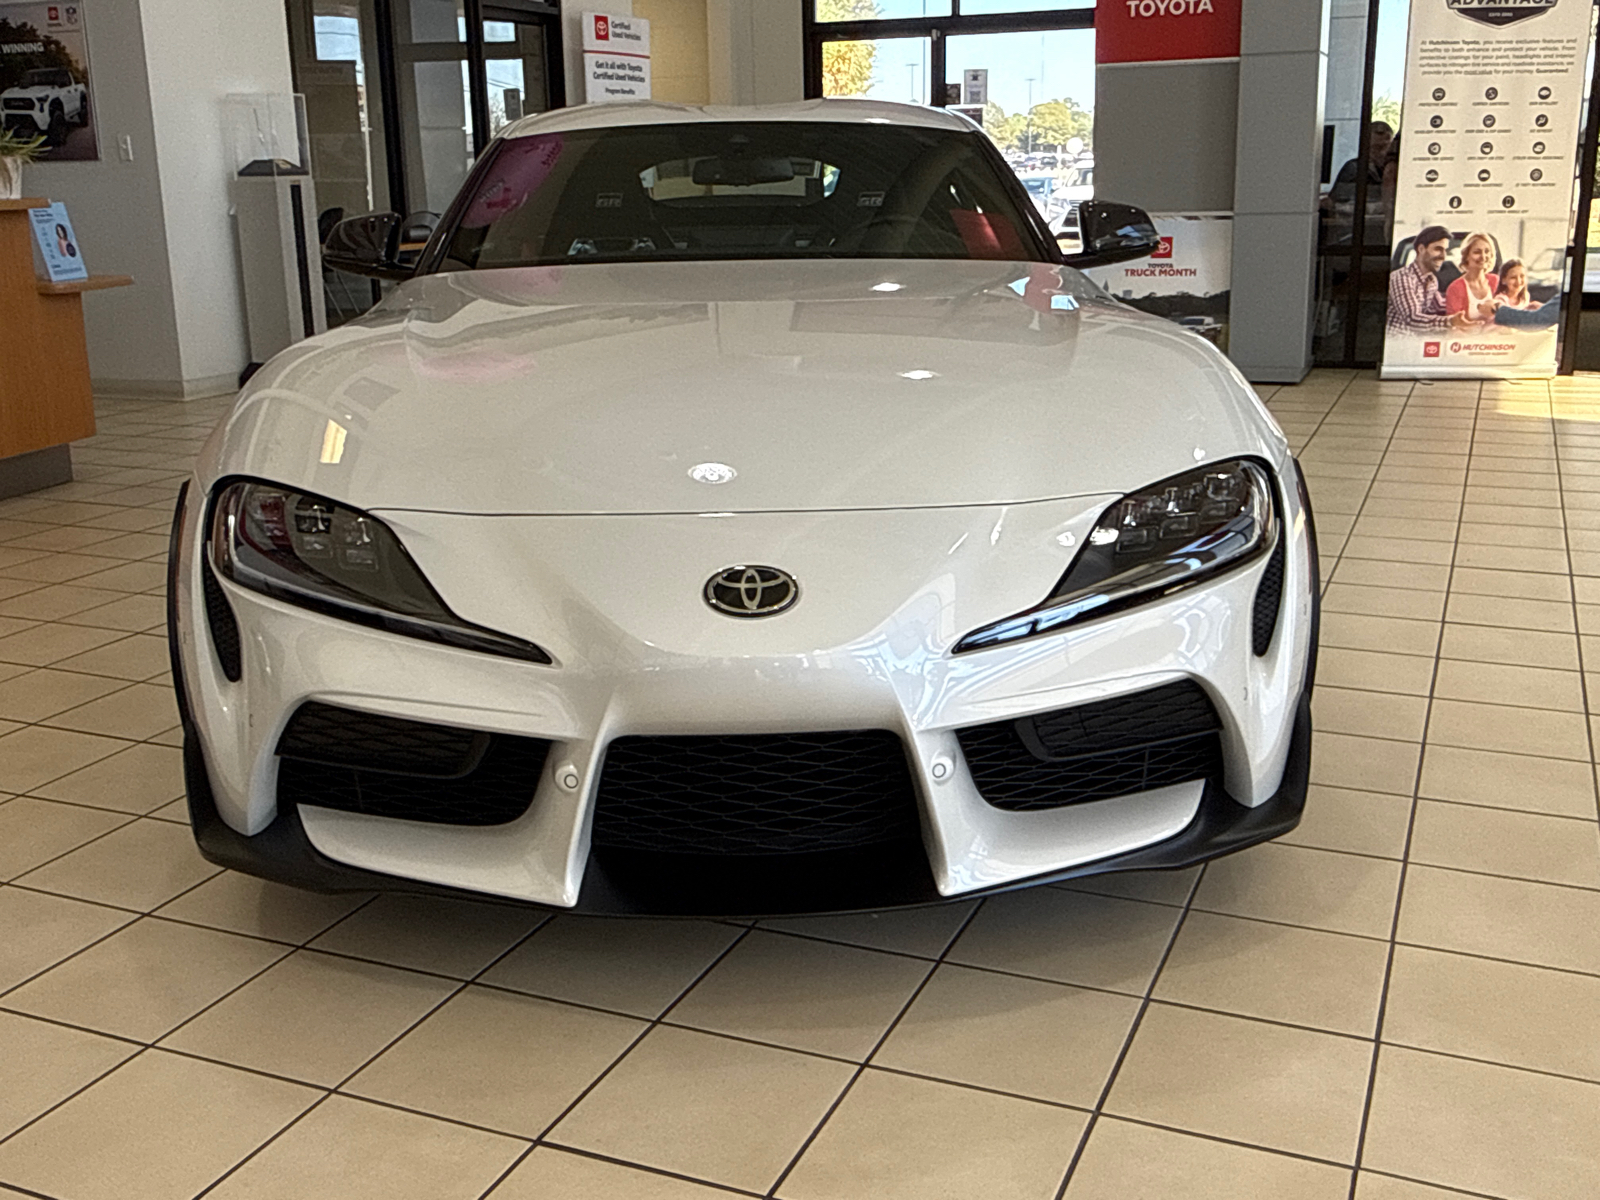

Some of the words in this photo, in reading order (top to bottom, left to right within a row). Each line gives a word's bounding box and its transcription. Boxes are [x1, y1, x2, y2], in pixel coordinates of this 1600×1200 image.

[1126, 0, 1214, 18] TOYOTA
[611, 20, 631, 30] Certified
[612, 30, 623, 38] Used
[624, 32, 642, 41] Vehicles
[1, 42, 44, 53] WINNING
[595, 61, 604, 69] Get
[616, 62, 627, 70] with
[627, 63, 643, 72] Toyota
[593, 71, 614, 80] Certified
[626, 74, 645, 83] Vehicles
[1125, 269, 1156, 277] TRUCK
[1158, 268, 1197, 276] MONTH
